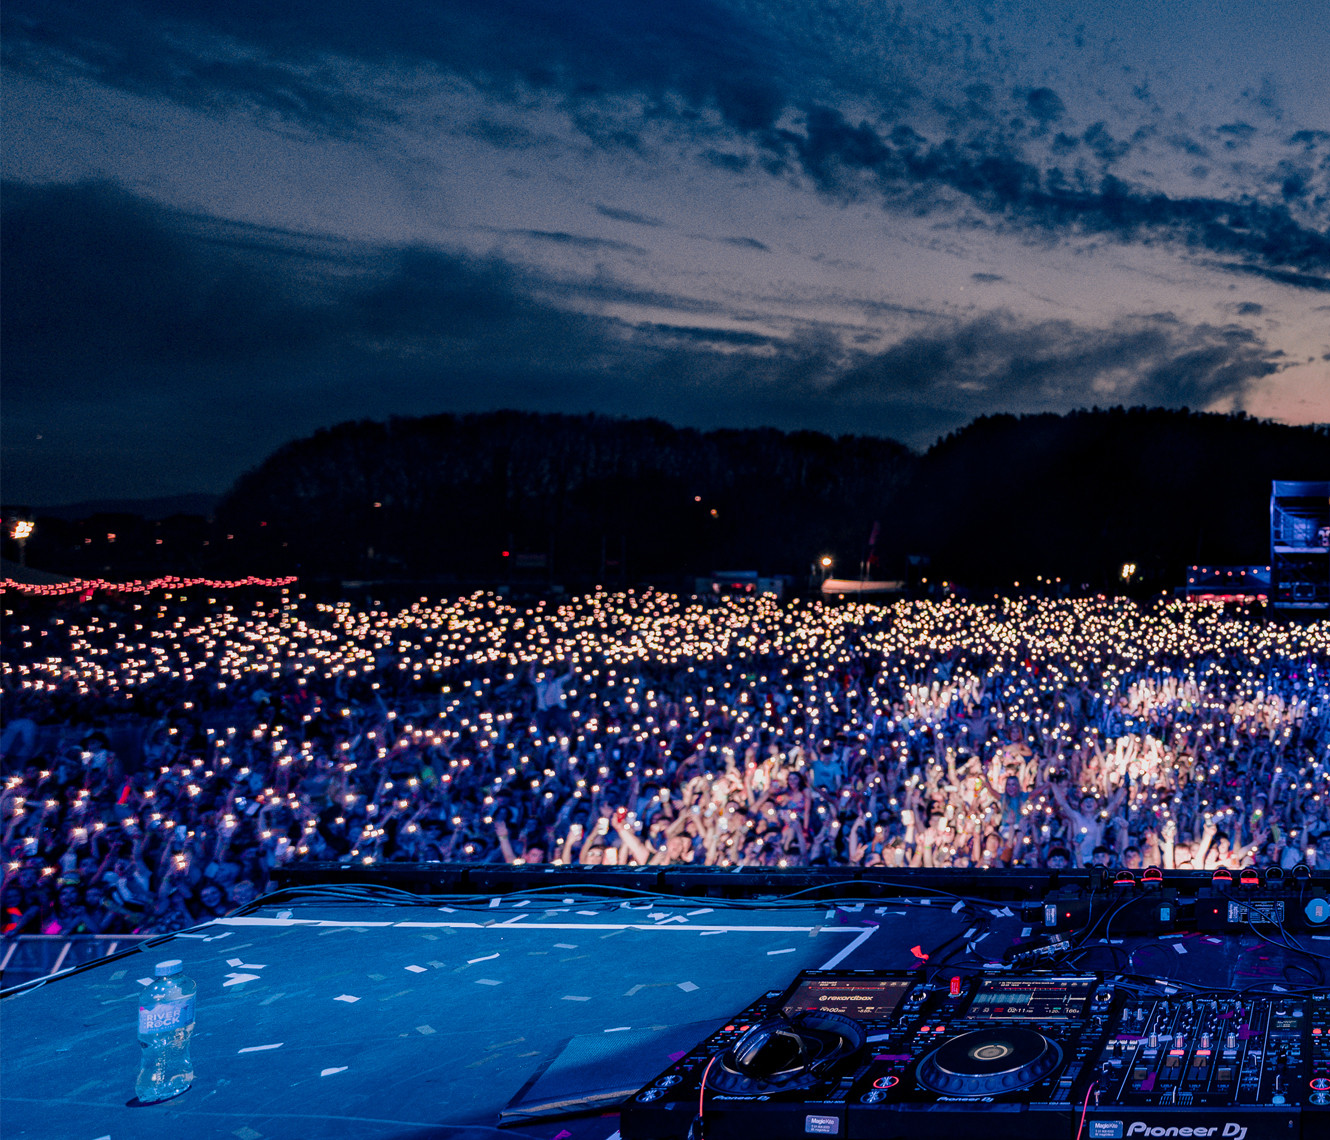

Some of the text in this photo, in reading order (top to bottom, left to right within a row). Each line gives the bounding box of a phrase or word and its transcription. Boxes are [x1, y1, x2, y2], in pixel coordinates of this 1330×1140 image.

[147, 1009, 180, 1021] RIVER
[146, 1016, 180, 1029] ROCK
[1126, 1121, 1218, 1137] Pioneer
